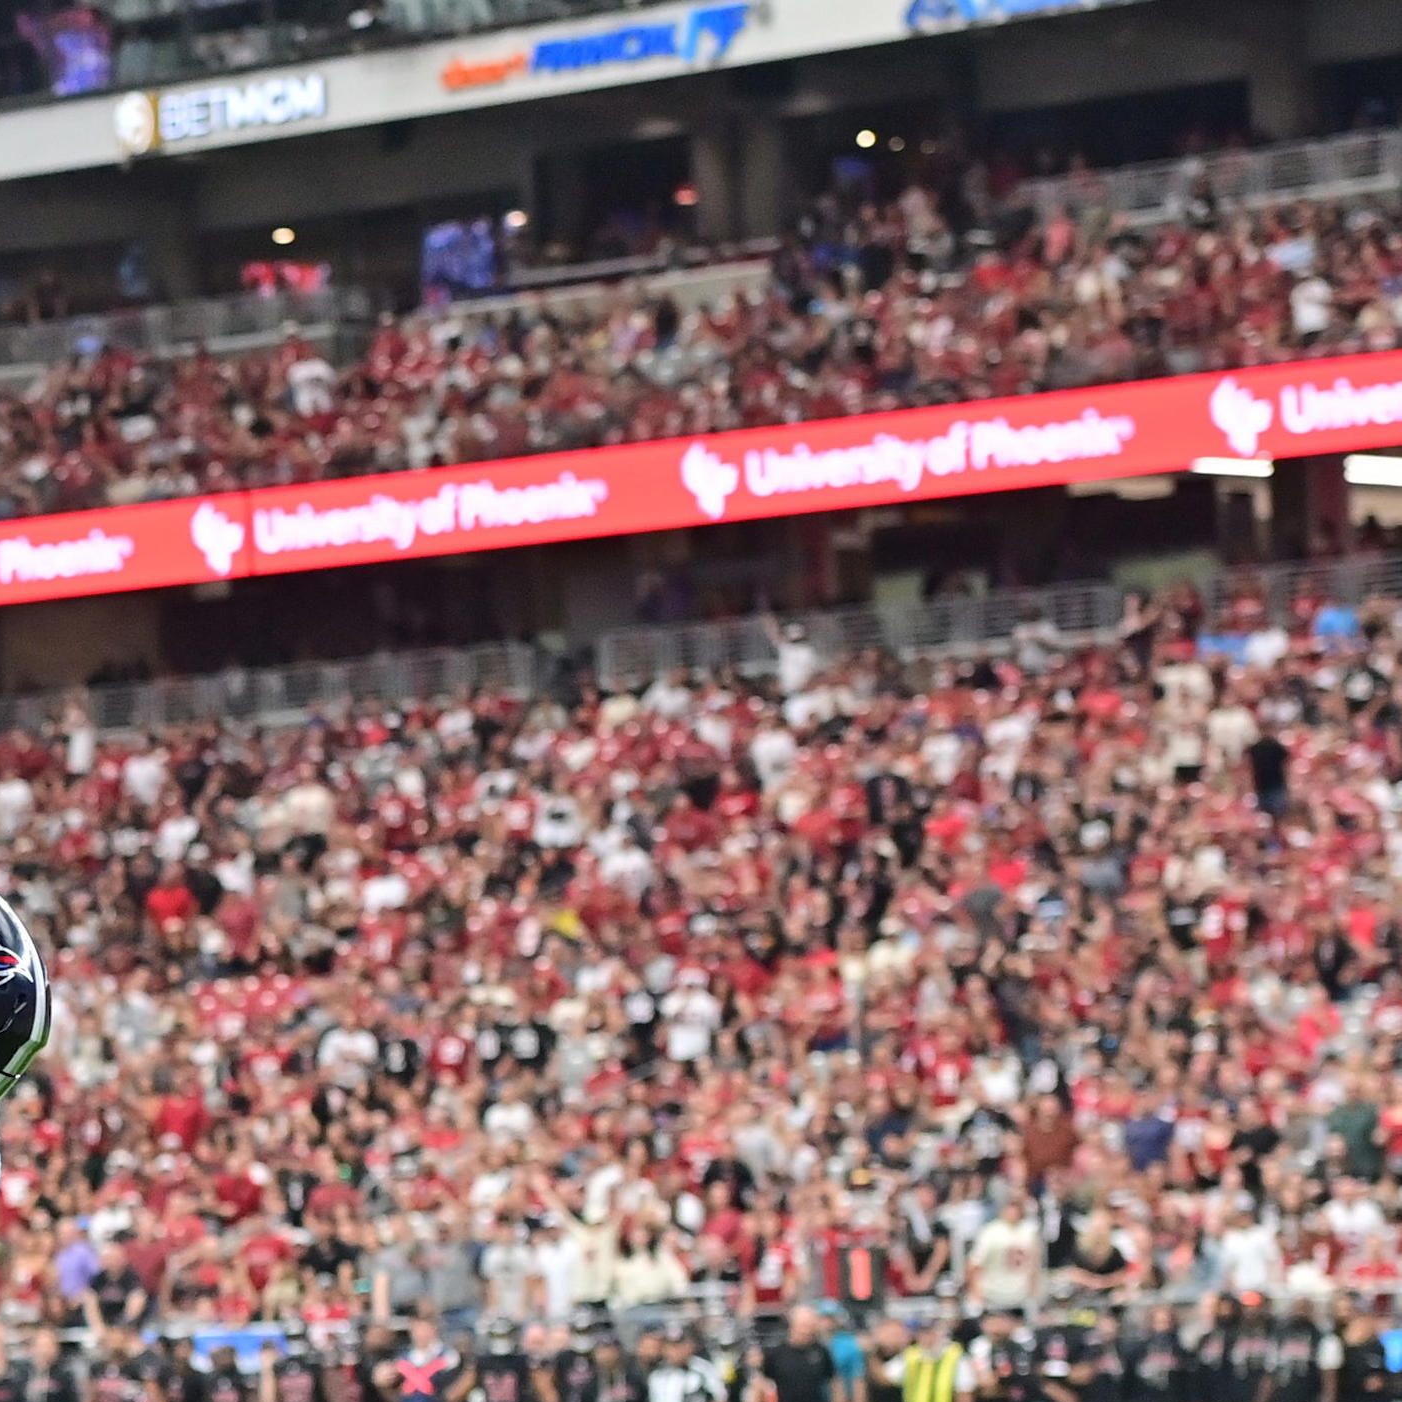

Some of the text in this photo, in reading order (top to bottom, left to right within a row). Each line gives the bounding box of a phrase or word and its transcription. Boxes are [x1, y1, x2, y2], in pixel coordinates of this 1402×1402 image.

[159, 73, 326, 140] BETMGM
[744, 407, 1133, 497] University of Phoenix
[253, 471, 606, 554] University of Phoenix
